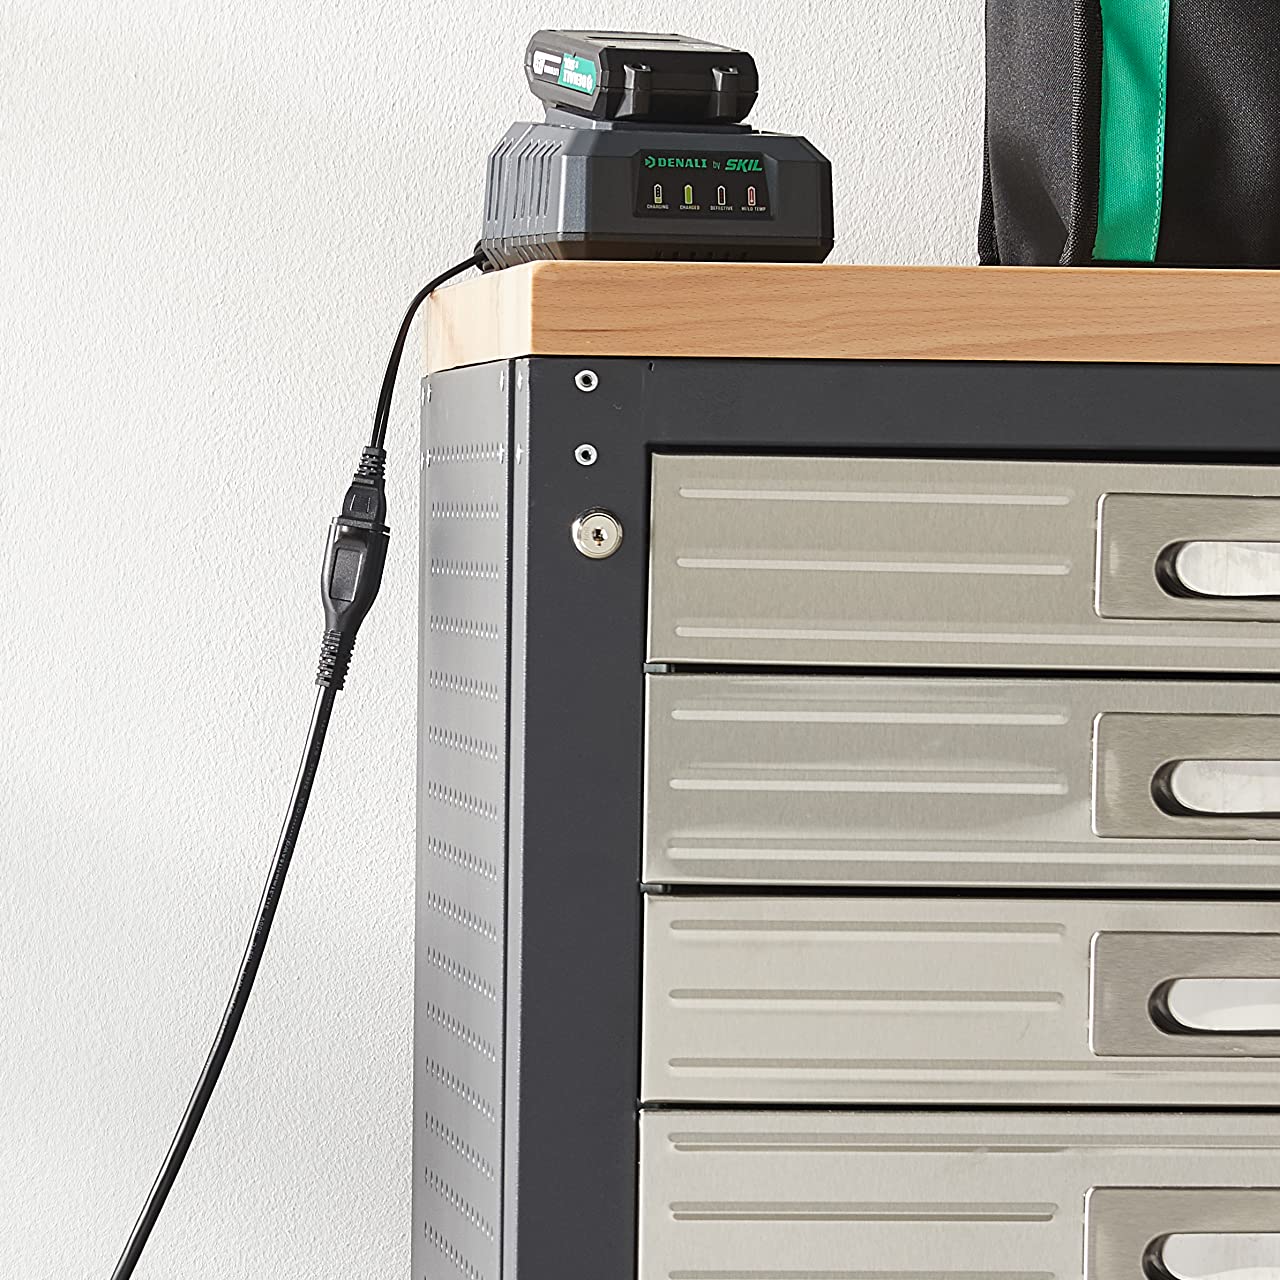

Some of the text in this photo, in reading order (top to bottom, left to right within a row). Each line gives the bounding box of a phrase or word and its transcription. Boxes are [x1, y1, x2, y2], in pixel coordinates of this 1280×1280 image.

[658, 158, 763, 172] DENALI by SKIL
